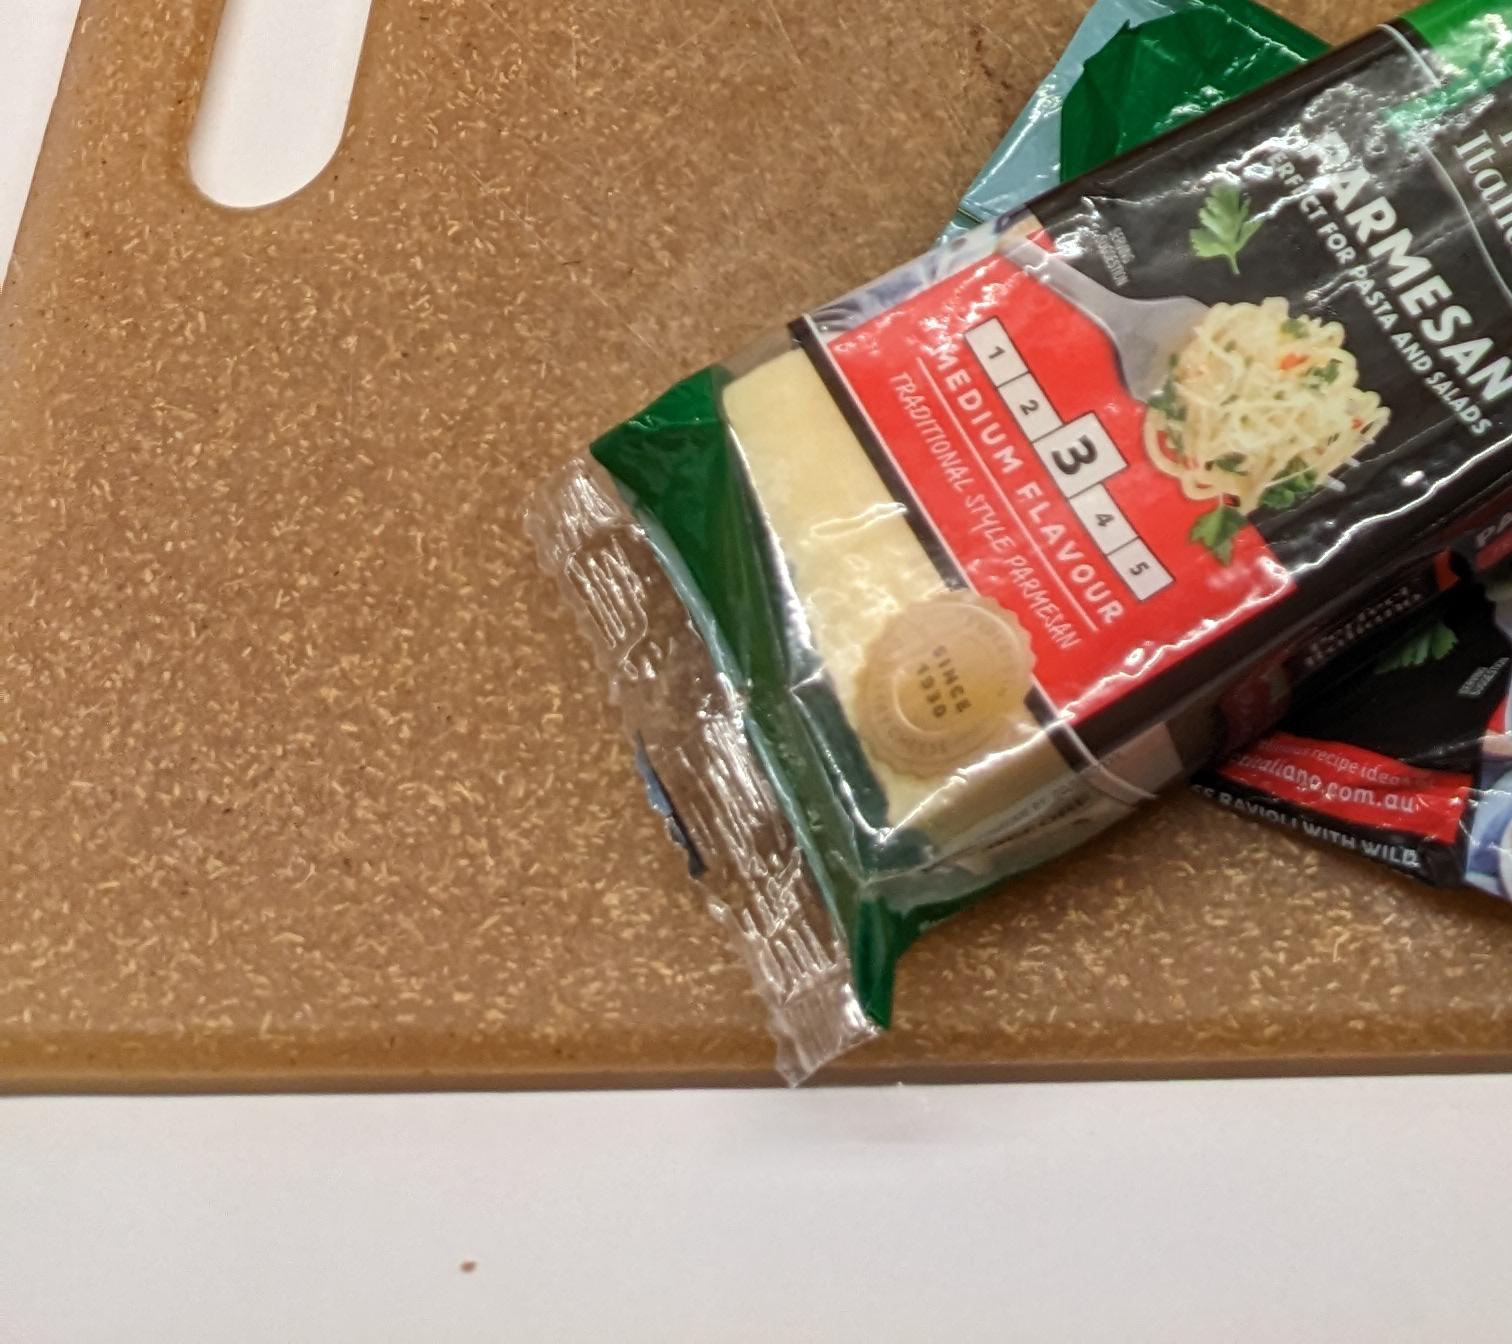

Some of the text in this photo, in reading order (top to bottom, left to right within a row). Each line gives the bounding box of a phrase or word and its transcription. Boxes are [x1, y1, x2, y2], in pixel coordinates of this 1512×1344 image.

[1317, 221, 1493, 437] FOR PASTA AND SALADS
[889, 371, 1083, 652] TRADITIONAL STYLE PARMESAN
[932, 344, 1126, 626] MEDIUM FLAVOUR
[988, 345, 1150, 577] 1 2 3 4 5
[915, 663, 948, 720] 1930
[931, 643, 974, 715] SINCE
[1217, 791, 1299, 830] RAVIOLI
[1301, 820, 1356, 850] WITH
[1359, 838, 1421, 870] WILD
